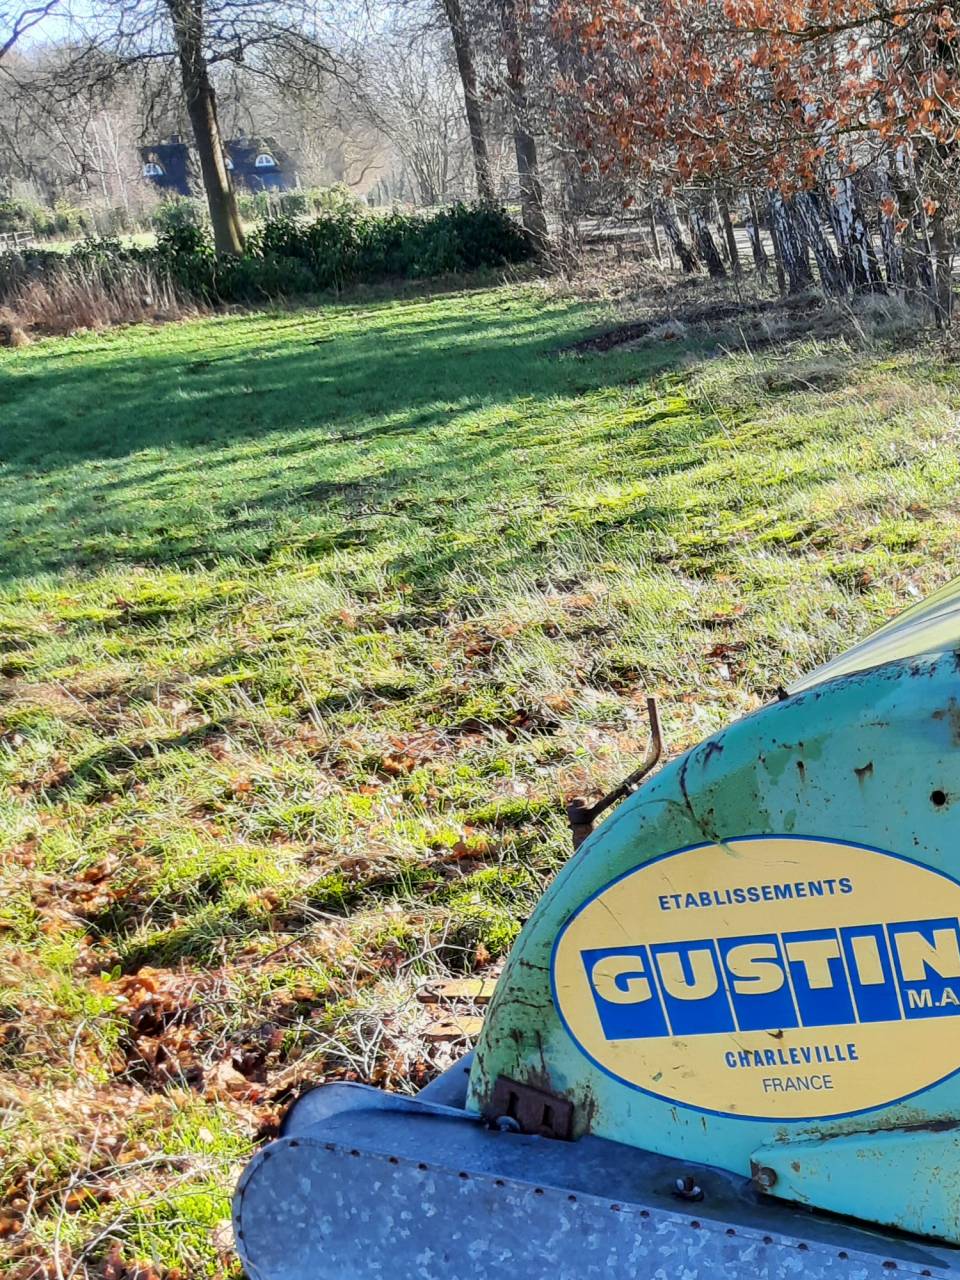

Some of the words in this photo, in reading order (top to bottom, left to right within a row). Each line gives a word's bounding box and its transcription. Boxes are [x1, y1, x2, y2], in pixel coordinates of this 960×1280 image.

[658, 877, 854, 911] ETABLISSEMENTS
[724, 1043, 859, 1069] CHARLEVILLE
[762, 1074, 834, 1093] FRANCE
